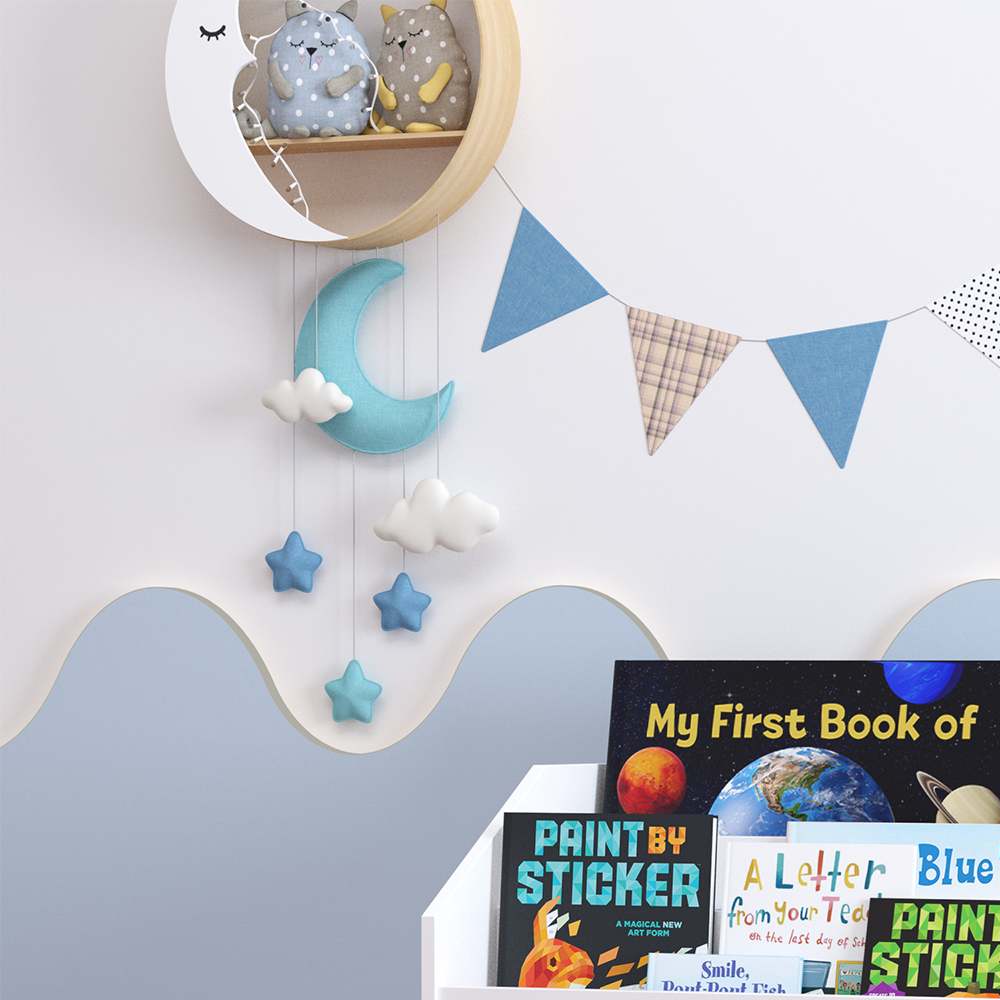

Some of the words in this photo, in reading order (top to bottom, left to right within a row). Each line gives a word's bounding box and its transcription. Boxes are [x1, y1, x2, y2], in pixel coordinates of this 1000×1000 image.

[646, 703, 699, 747] My
[711, 703, 807, 739] First
[820, 703, 921, 741] Book
[934, 704, 980, 740] of
[534, 820, 644, 857] PAINT
[648, 826, 686, 855] BY
[743, 858, 763, 891] A
[775, 850, 886, 892] Letter
[918, 843, 993, 888] Blue
[517, 860, 701, 908] STICKER
[615, 920, 622, 928] A
[624, 920, 661, 928] MAGICAL
[662, 921, 683, 929] NEW
[728, 896, 771, 928] from
[774, 901, 818, 925] your
[628, 929, 644, 937] ART
[646, 929, 670, 937] FORM
[749, 932, 762, 941] on
[766, 931, 783, 944] the
[788, 929, 811, 945] last
[816, 932, 832, 950] day
[837, 937, 849, 950] of
[701, 960, 750, 980] Smile,
